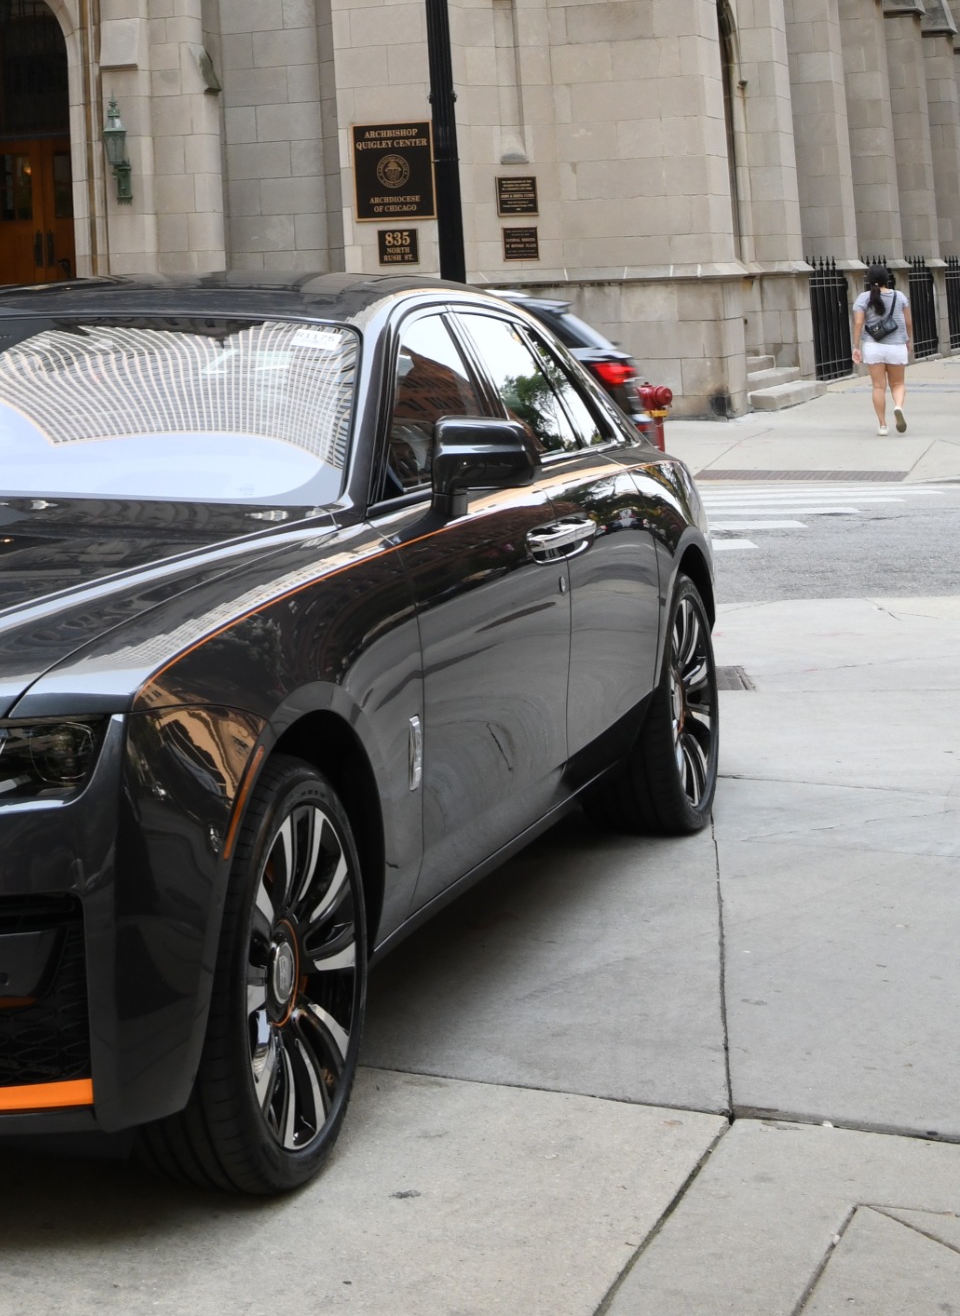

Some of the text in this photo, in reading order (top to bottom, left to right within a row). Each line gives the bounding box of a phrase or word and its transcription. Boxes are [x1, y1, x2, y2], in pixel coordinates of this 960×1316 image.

[364, 128, 418, 139] ARCHBISHOP
[355, 138, 428, 151] QUIGLEY CENTER
[369, 195, 421, 204] ARCHDIOCESE
[384, 204, 417, 212] CHICAGO
[385, 231, 410, 246] 835
[386, 246, 410, 254] NORTH
